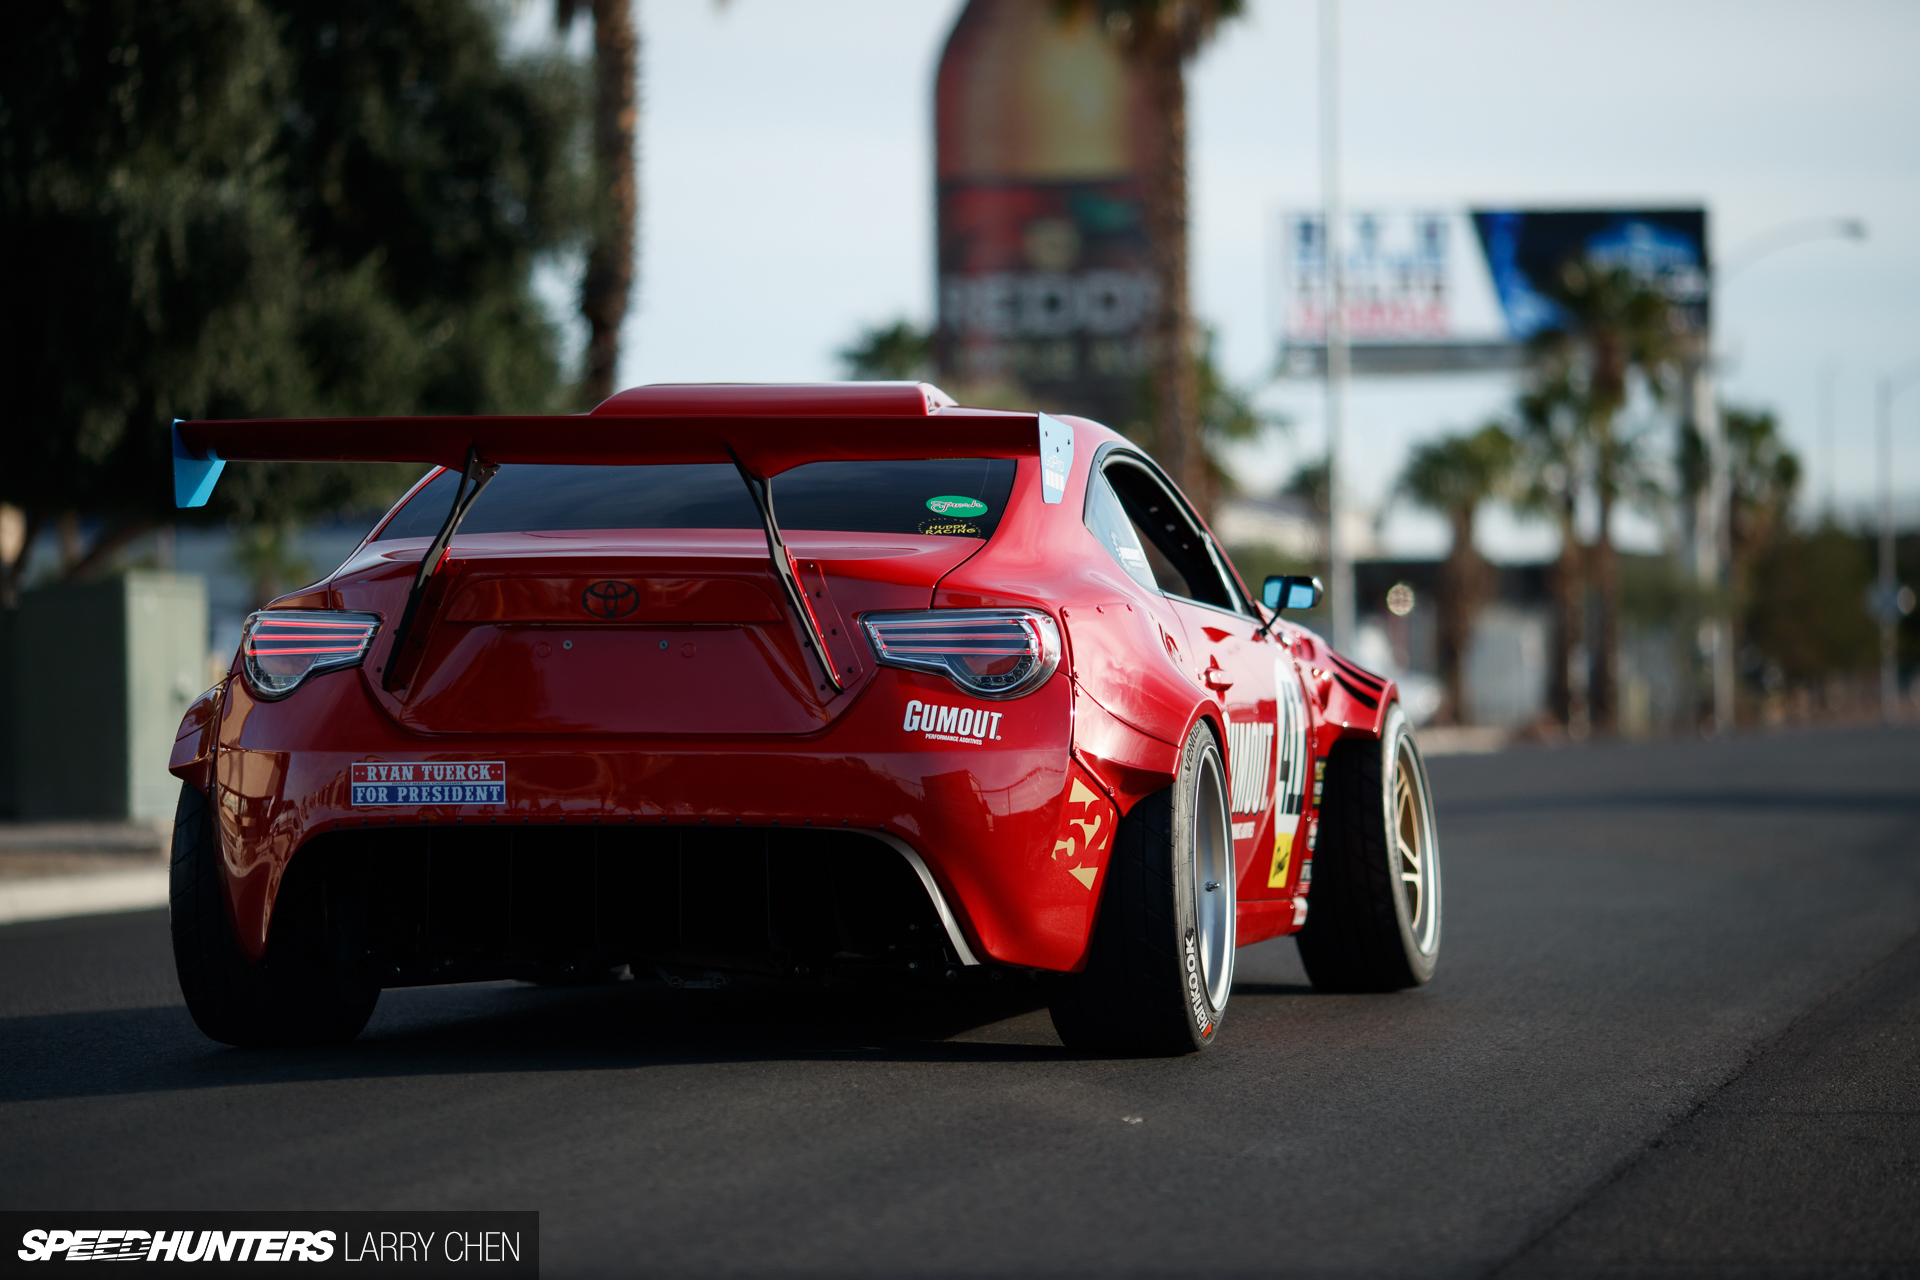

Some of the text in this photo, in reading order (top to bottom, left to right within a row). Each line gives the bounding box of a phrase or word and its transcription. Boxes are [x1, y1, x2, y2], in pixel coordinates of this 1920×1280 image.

[1044, 451, 1065, 473] GoPro
[903, 699, 1003, 740] GUMOUT
[925, 733, 983, 746] PERFORMANCE ADDITIVES
[366, 764, 491, 781] RYAN TUERCK
[1222, 710, 1274, 817] UMOUT
[356, 785, 501, 803] FOR PRESIDENT
